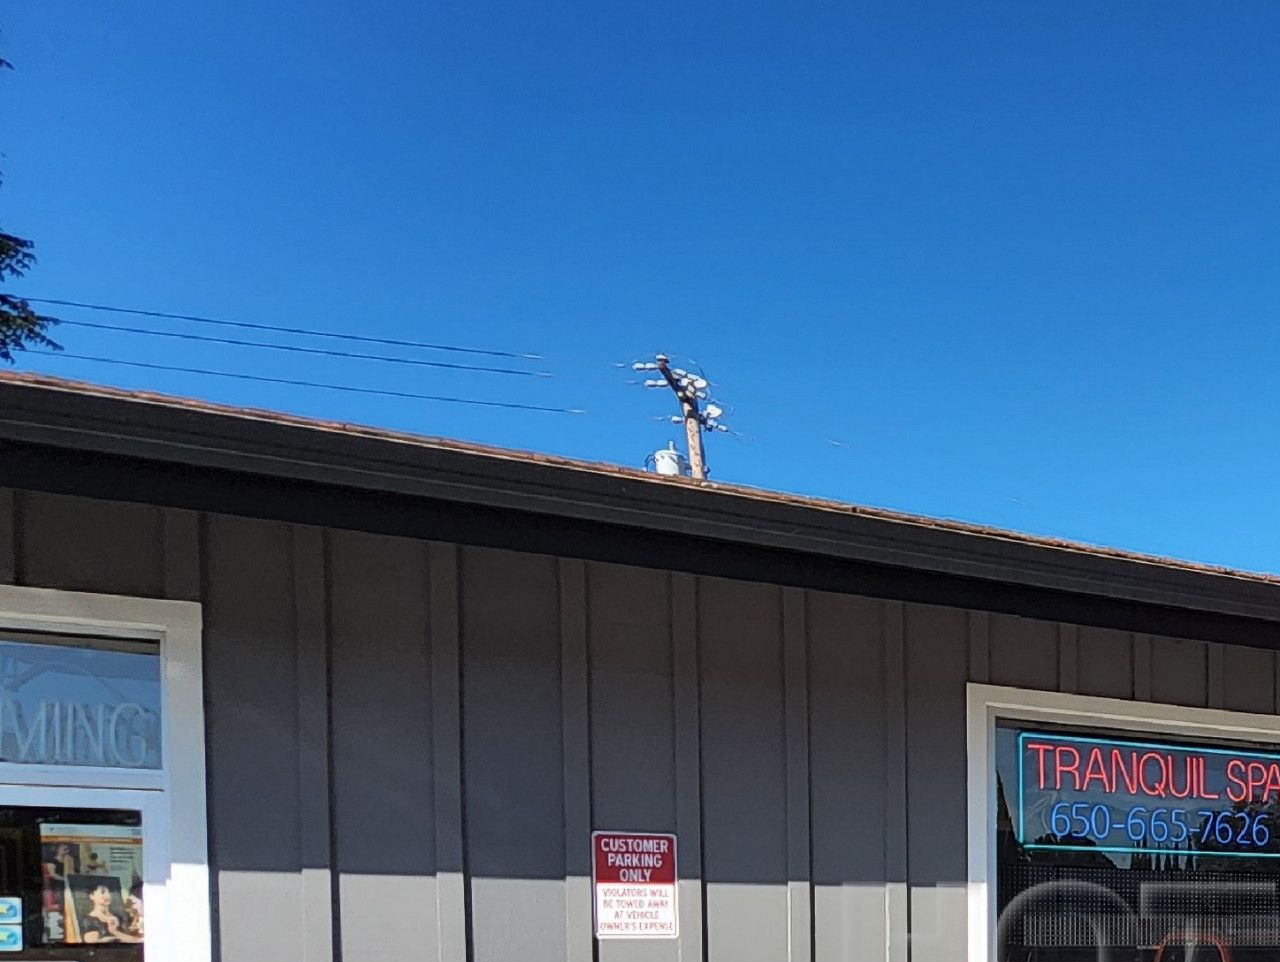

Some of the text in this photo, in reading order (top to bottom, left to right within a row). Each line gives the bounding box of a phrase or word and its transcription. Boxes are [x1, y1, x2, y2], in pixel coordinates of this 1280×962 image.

[1028, 744, 1219, 799] TRANQUIL
[1051, 803, 1271, 846] 650-665-7626
[600, 838, 669, 853] CUSTOMER
[607, 853, 663, 868] PARKING
[619, 868, 653, 882] ONLY
[602, 888, 669, 898] VIOLATORS WILL
[603, 900, 613, 909] BE
[616, 900, 645, 909] TOWED
[614, 910, 660, 920] AT VEHICLE
